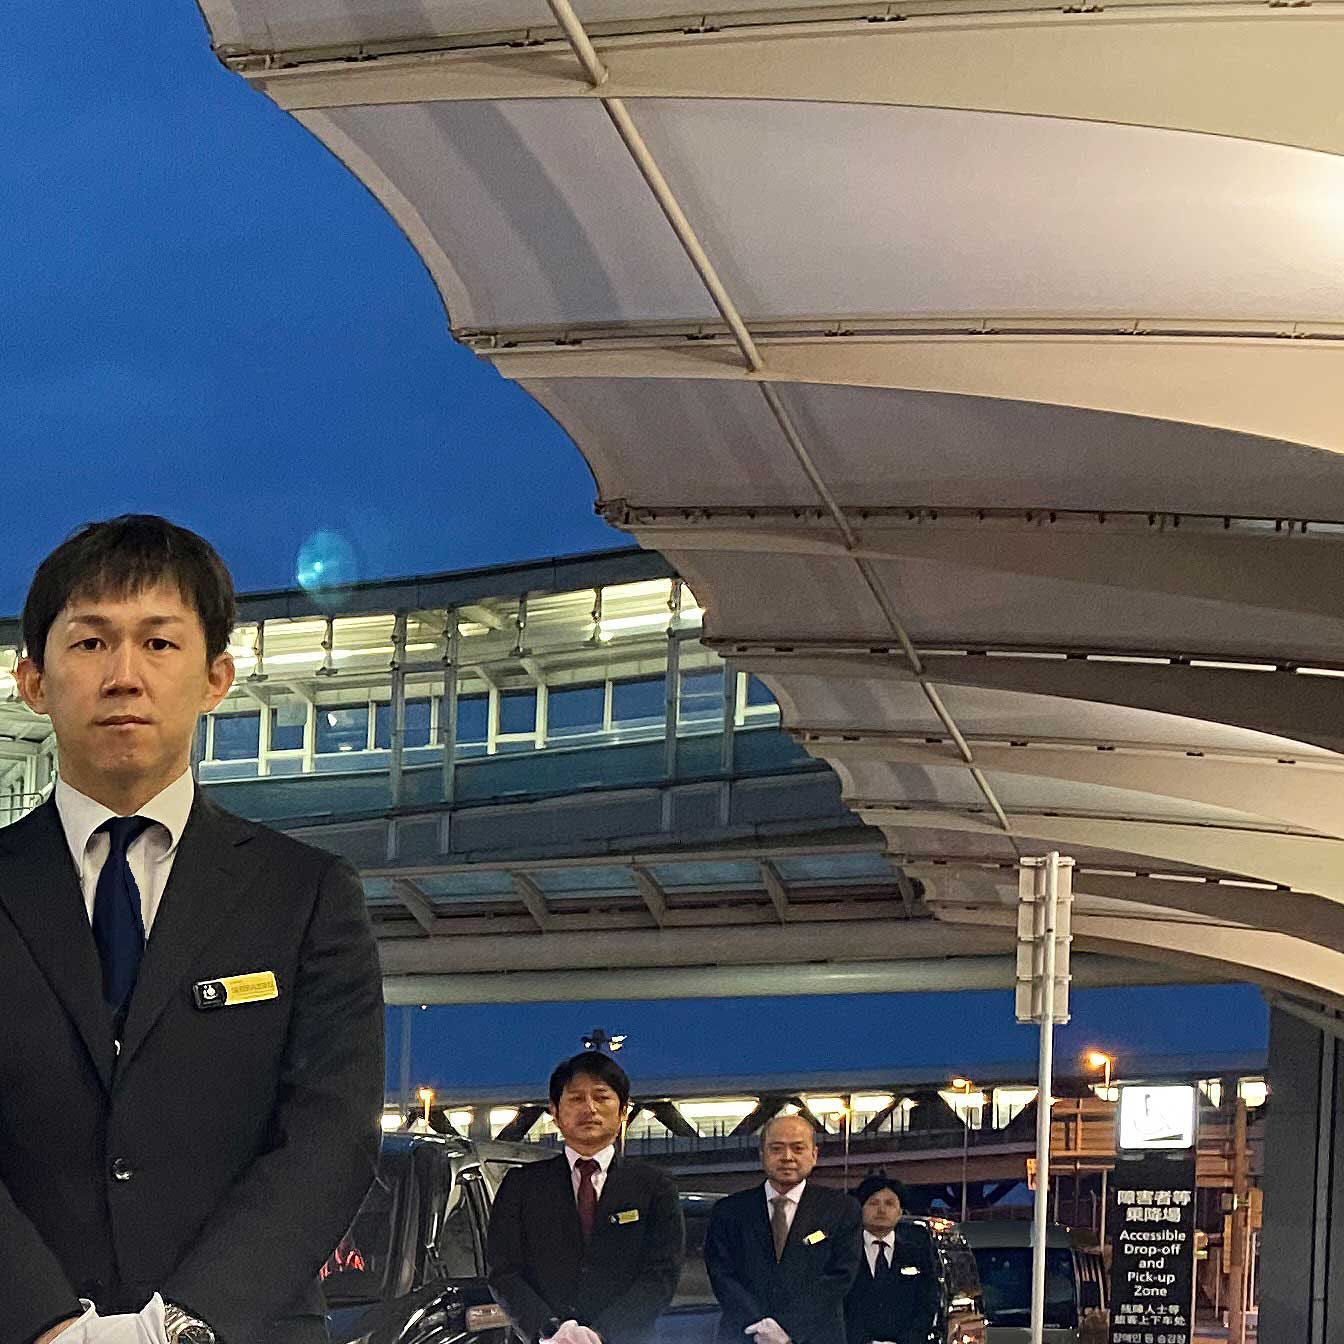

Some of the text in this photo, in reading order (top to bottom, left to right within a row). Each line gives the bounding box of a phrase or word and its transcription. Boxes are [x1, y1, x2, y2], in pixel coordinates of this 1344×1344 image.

[1119, 1229, 1186, 1241] Accessible
[1124, 1243, 1181, 1257] Drop-off
[1138, 1257, 1164, 1269] and
[1127, 1271, 1176, 1285] Pick-up
[1134, 1285, 1168, 1297] Zone
